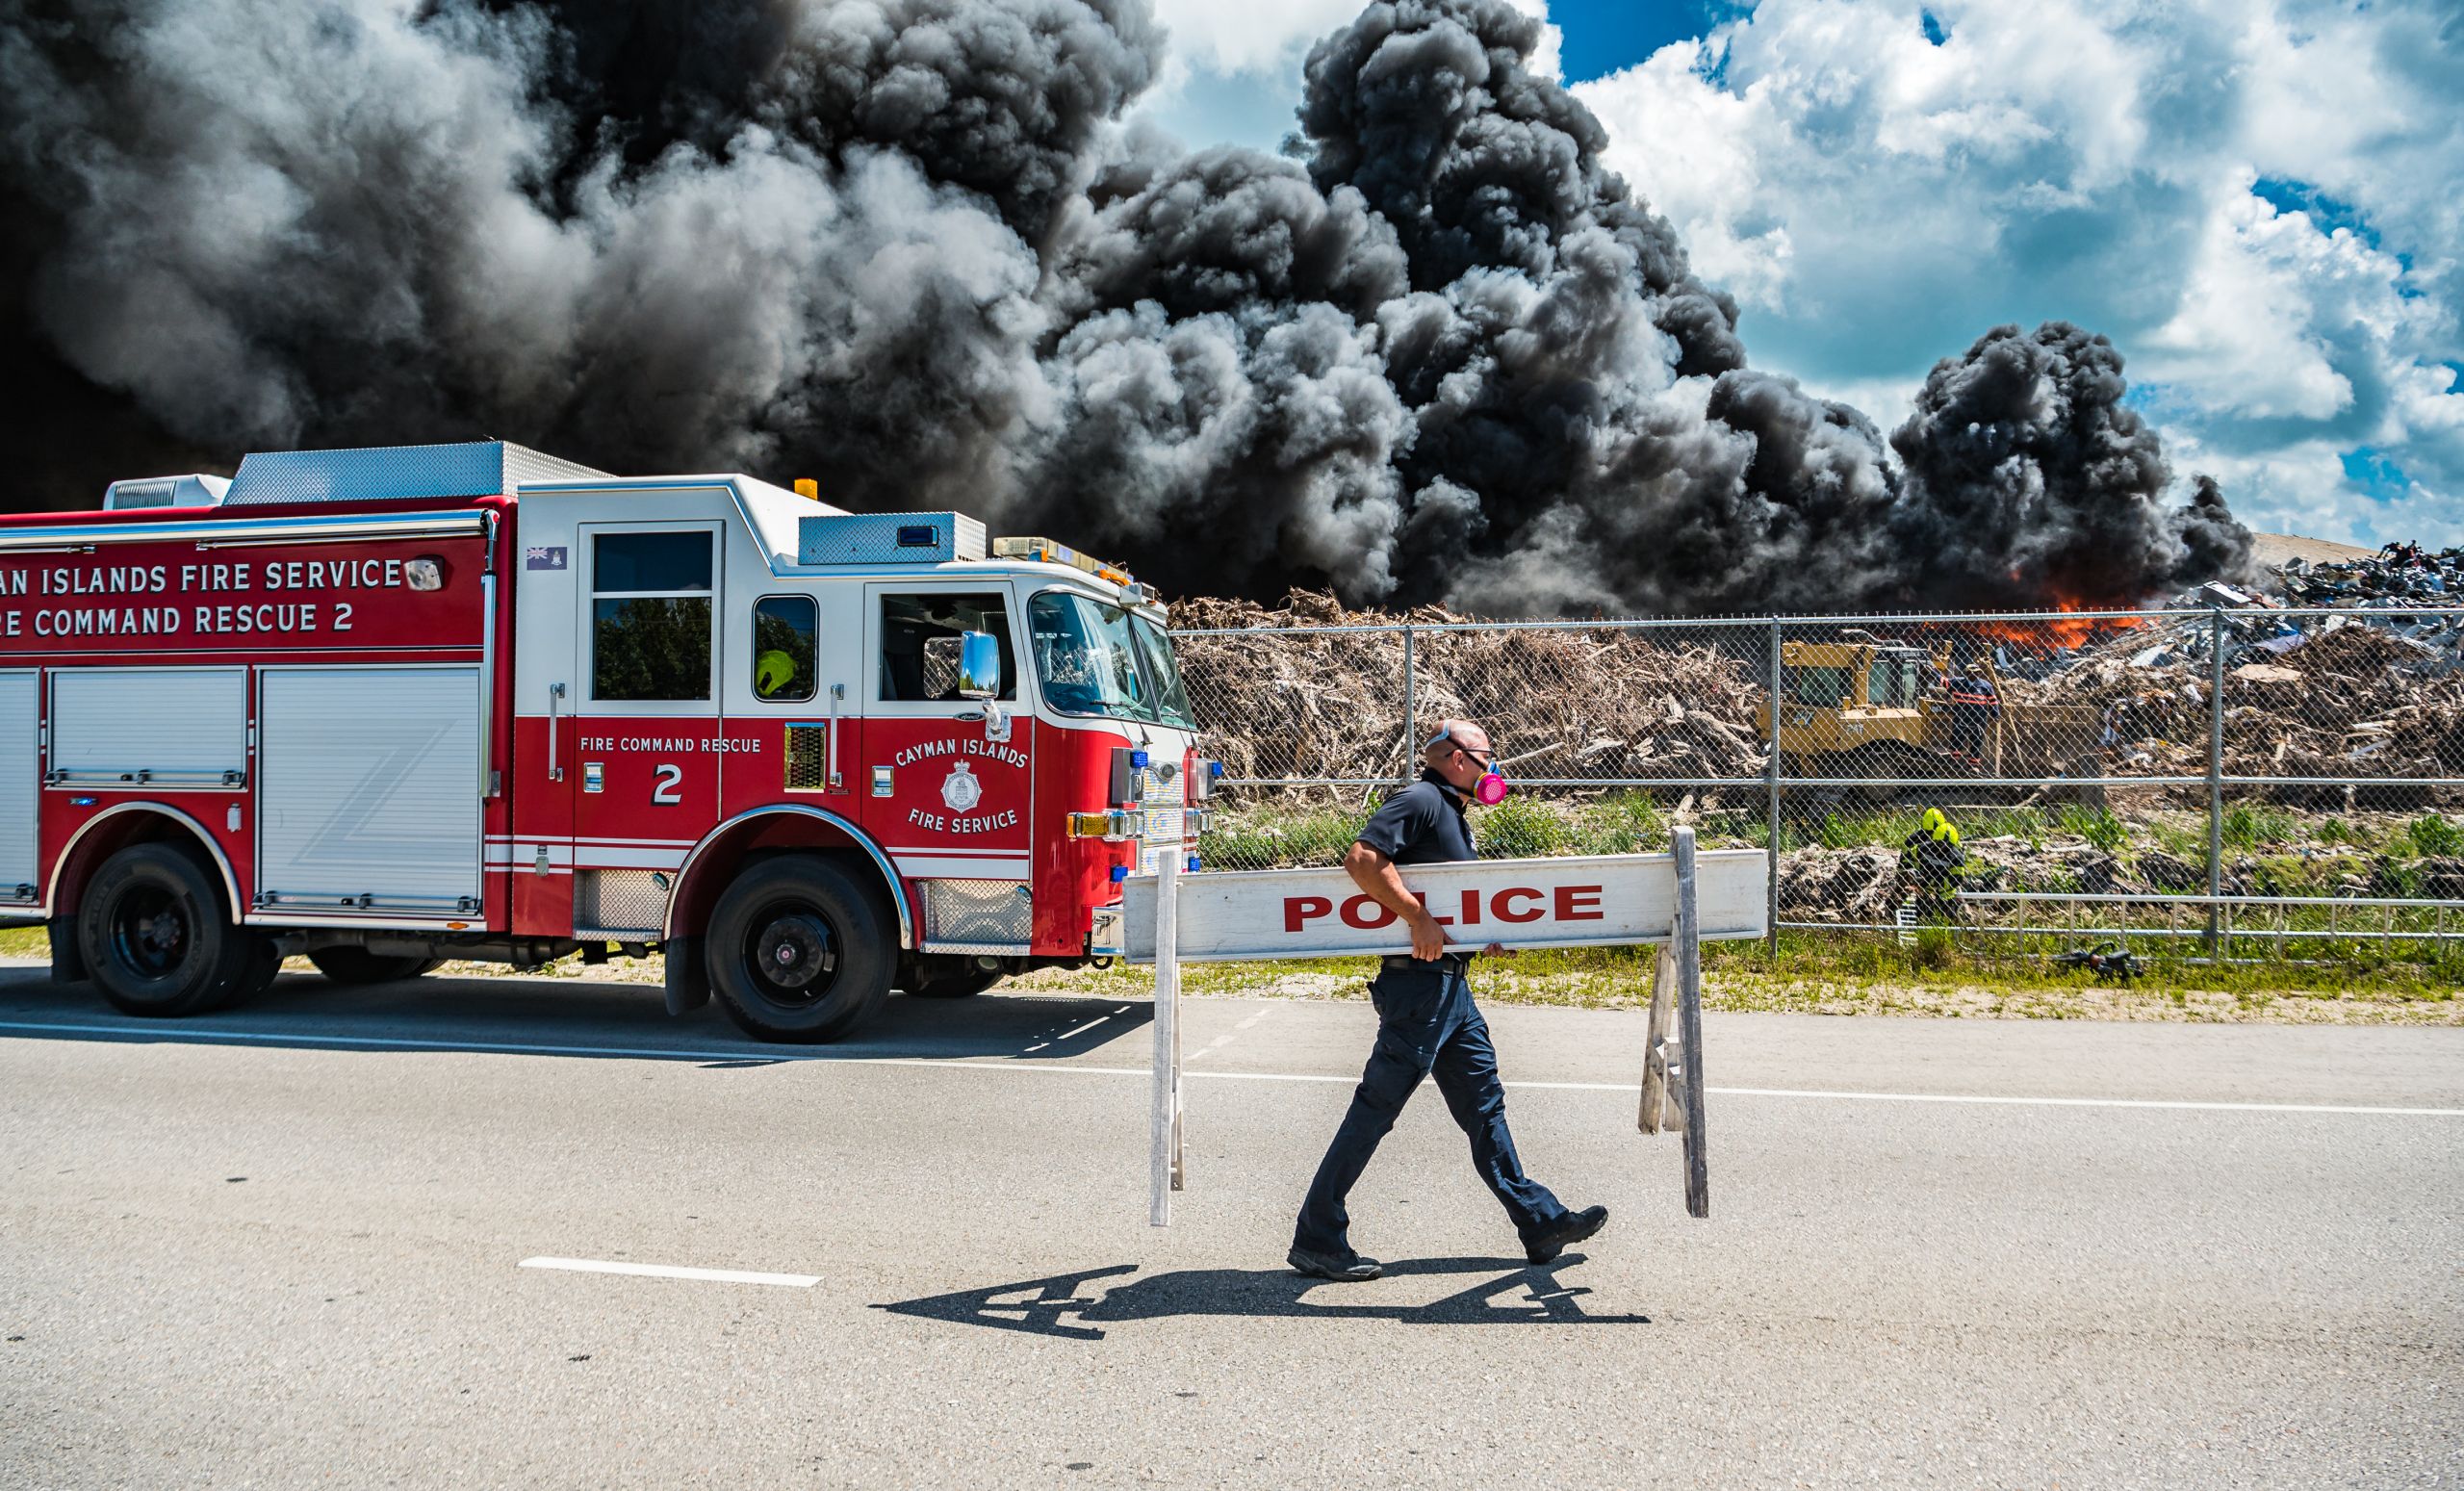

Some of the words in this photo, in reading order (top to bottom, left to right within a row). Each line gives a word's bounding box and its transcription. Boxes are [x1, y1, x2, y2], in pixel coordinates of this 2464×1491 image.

[42, 565, 167, 596] ISLANDS
[181, 563, 250, 591] FIRE
[266, 559, 401, 589] SERVICE
[0, 610, 22, 637] E
[35, 607, 181, 636] COMMAND
[195, 604, 317, 633] RESCUE
[334, 603, 353, 630] 2
[580, 737, 614, 752] FIRE
[620, 737, 695, 753] COMMAND
[701, 738, 761, 754] RESCUE
[895, 738, 956, 767] CAYMAN
[962, 738, 1029, 769] ISLANDS
[653, 763, 682, 805] 2
[908, 808, 944, 832] FIRE
[951, 809, 1018, 835] SERVICE
